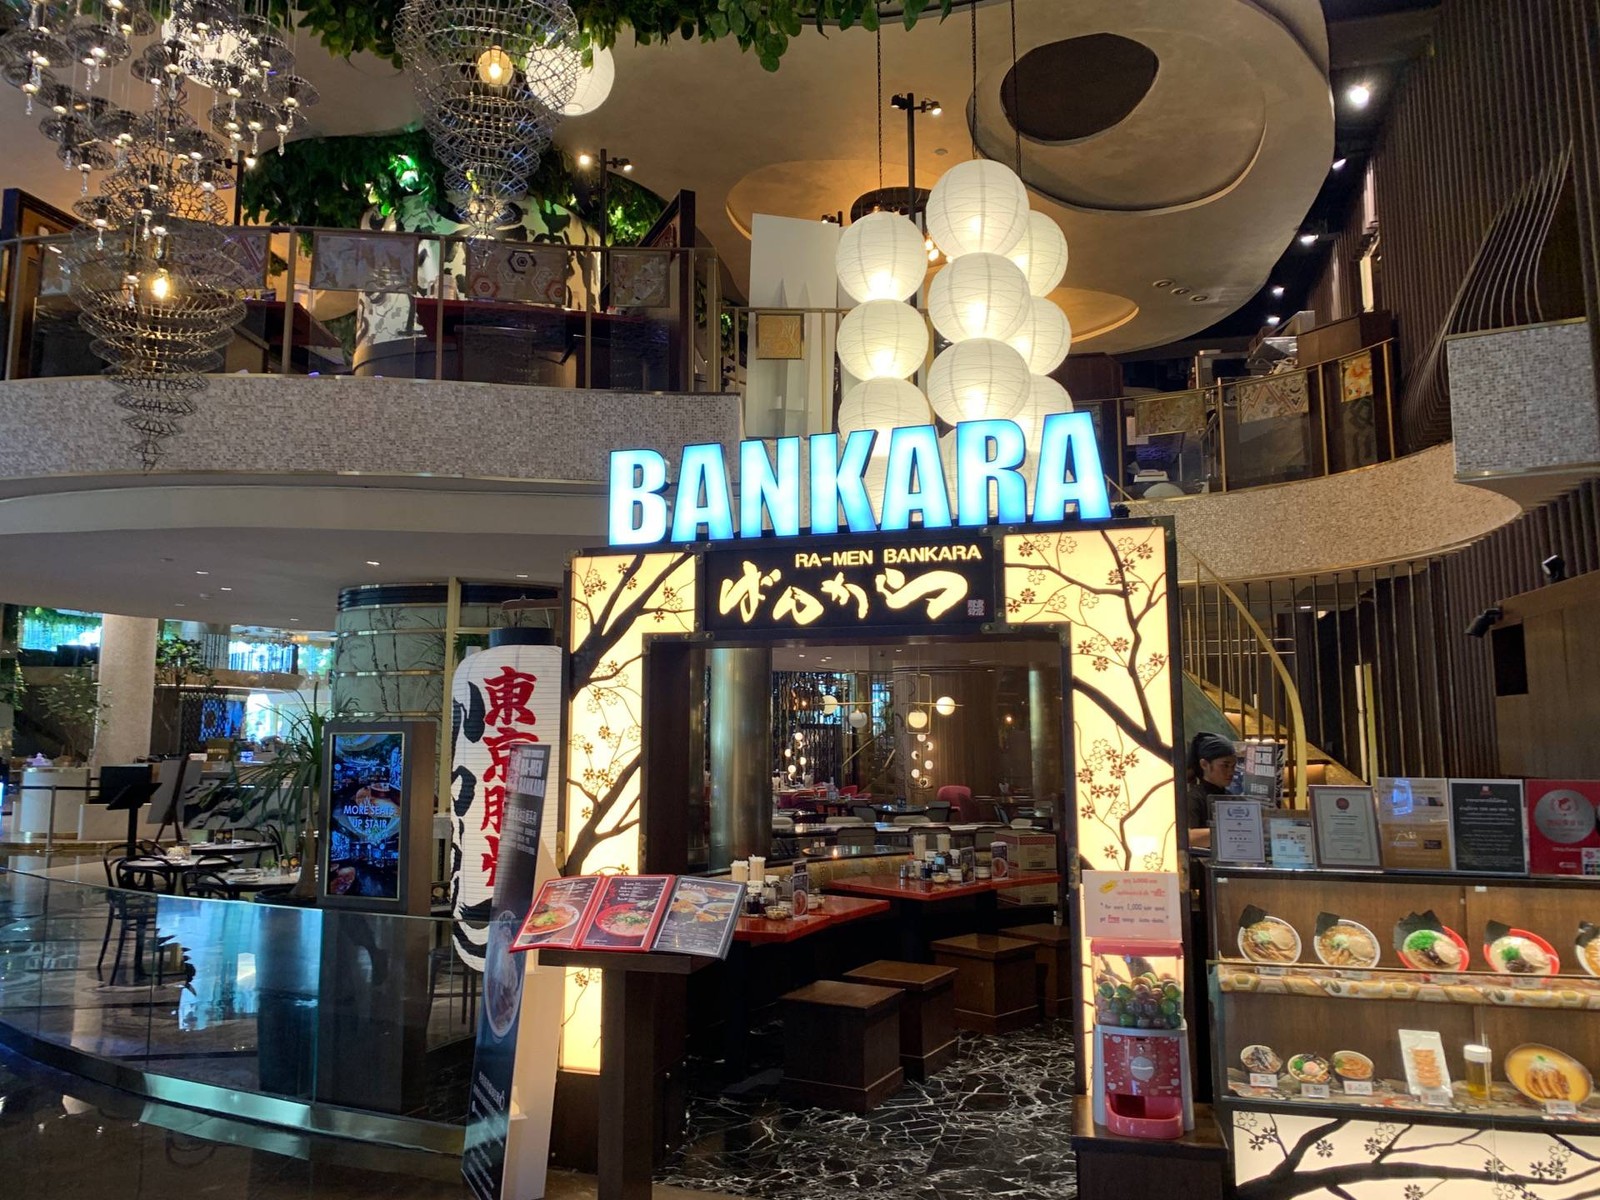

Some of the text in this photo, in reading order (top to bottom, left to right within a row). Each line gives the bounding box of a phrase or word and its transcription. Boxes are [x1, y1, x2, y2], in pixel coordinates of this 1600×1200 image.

[608, 411, 1112, 546] BANKARA
[795, 544, 983, 568] RA-MEN BANKARA
[343, 804, 369, 815] MORE
[352, 819, 363, 829] UP
